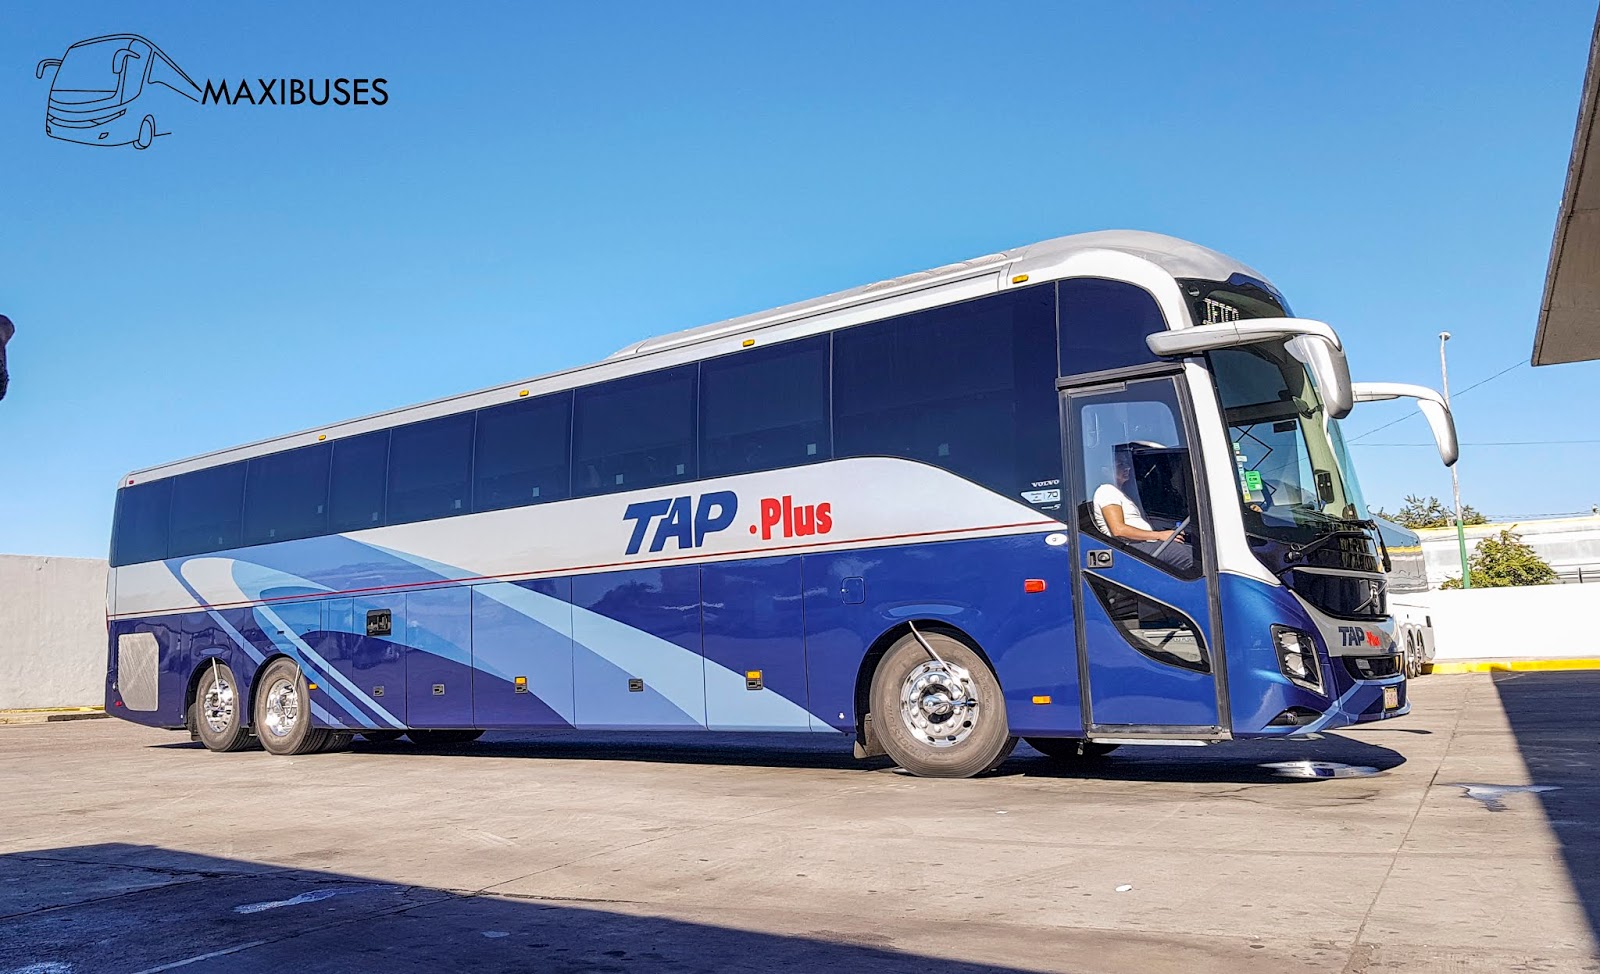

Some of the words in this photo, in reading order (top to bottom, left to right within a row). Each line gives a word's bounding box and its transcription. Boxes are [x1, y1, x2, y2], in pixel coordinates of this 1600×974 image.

[1031, 479, 1060, 487] VOLVO
[1047, 490, 1059, 499] 70
[622, 490, 739, 556] TAP
[1338, 626, 1365, 647] TAP
